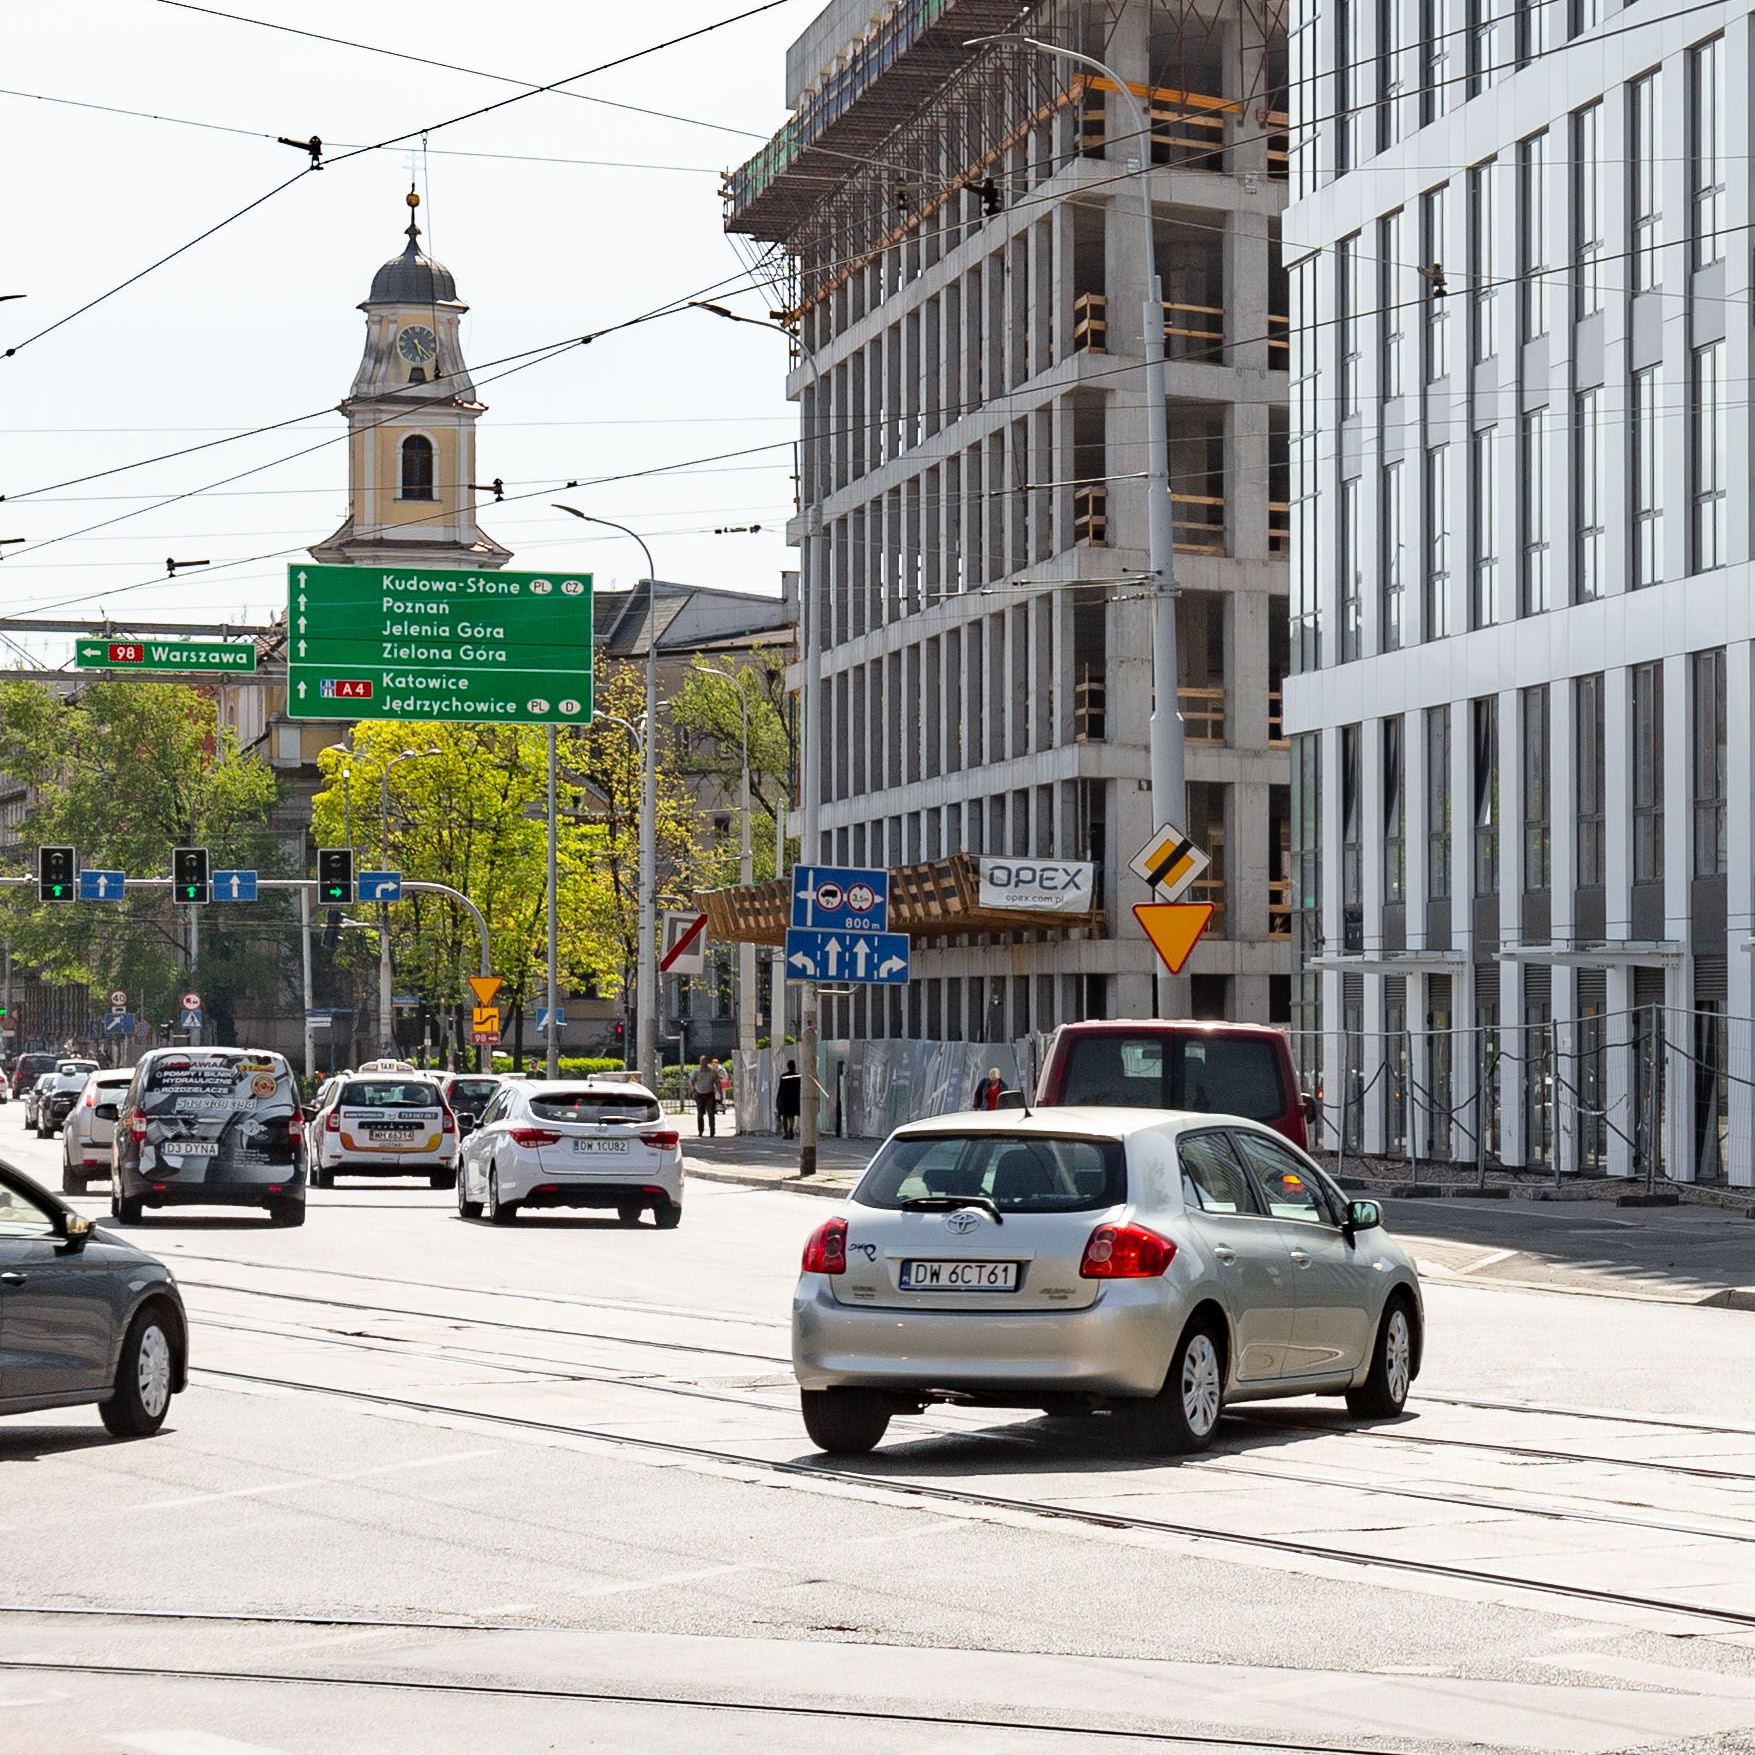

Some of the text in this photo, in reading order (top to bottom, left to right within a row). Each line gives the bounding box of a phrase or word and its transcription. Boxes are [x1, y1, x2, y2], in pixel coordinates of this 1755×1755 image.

[382, 574, 579, 595] Kudowa-Słone PL CZ
[382, 596, 450, 614] Poznań
[382, 620, 505, 639] Jelenia Góra
[116, 646, 248, 664] 98 Warszawa
[382, 642, 507, 662] Zielona Góra
[342, 682, 364, 696] A 4
[382, 672, 469, 691] Katowice
[381, 695, 517, 717] Jędrzychowice
[530, 700, 545, 712] PL
[988, 865, 1083, 891] OPEX
[845, 917, 870, 929] 800
[112, 994, 126, 1003] 40
[475, 1034, 487, 1043] 98
[167, 1143, 216, 1155] D3 DYNA
[580, 1141, 626, 1152] DW 1CU82
[914, 1263, 941, 1284] DW
[949, 1264, 1009, 1285] 6CT61
